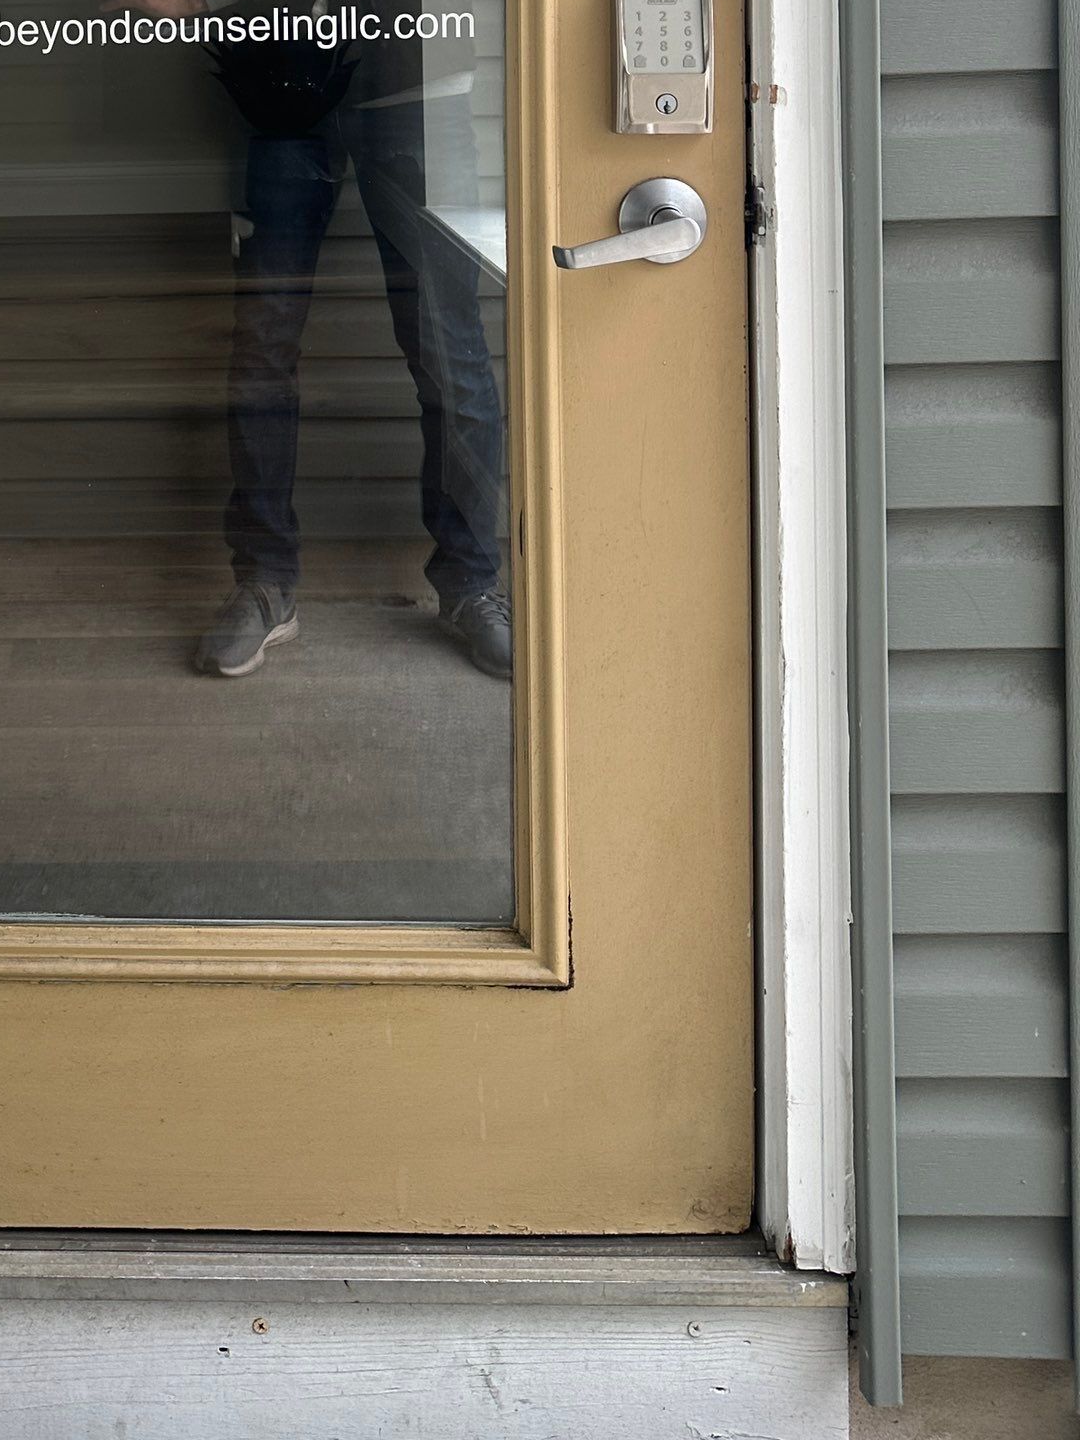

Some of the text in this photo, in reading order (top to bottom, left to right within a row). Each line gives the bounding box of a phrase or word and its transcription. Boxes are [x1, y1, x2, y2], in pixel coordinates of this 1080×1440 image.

[635, 11, 691, 21] 1 2 3
[634, 26, 692, 36] 4 5 6
[636, 41, 692, 51] 7 8 9
[660, 56, 668, 67] 0
